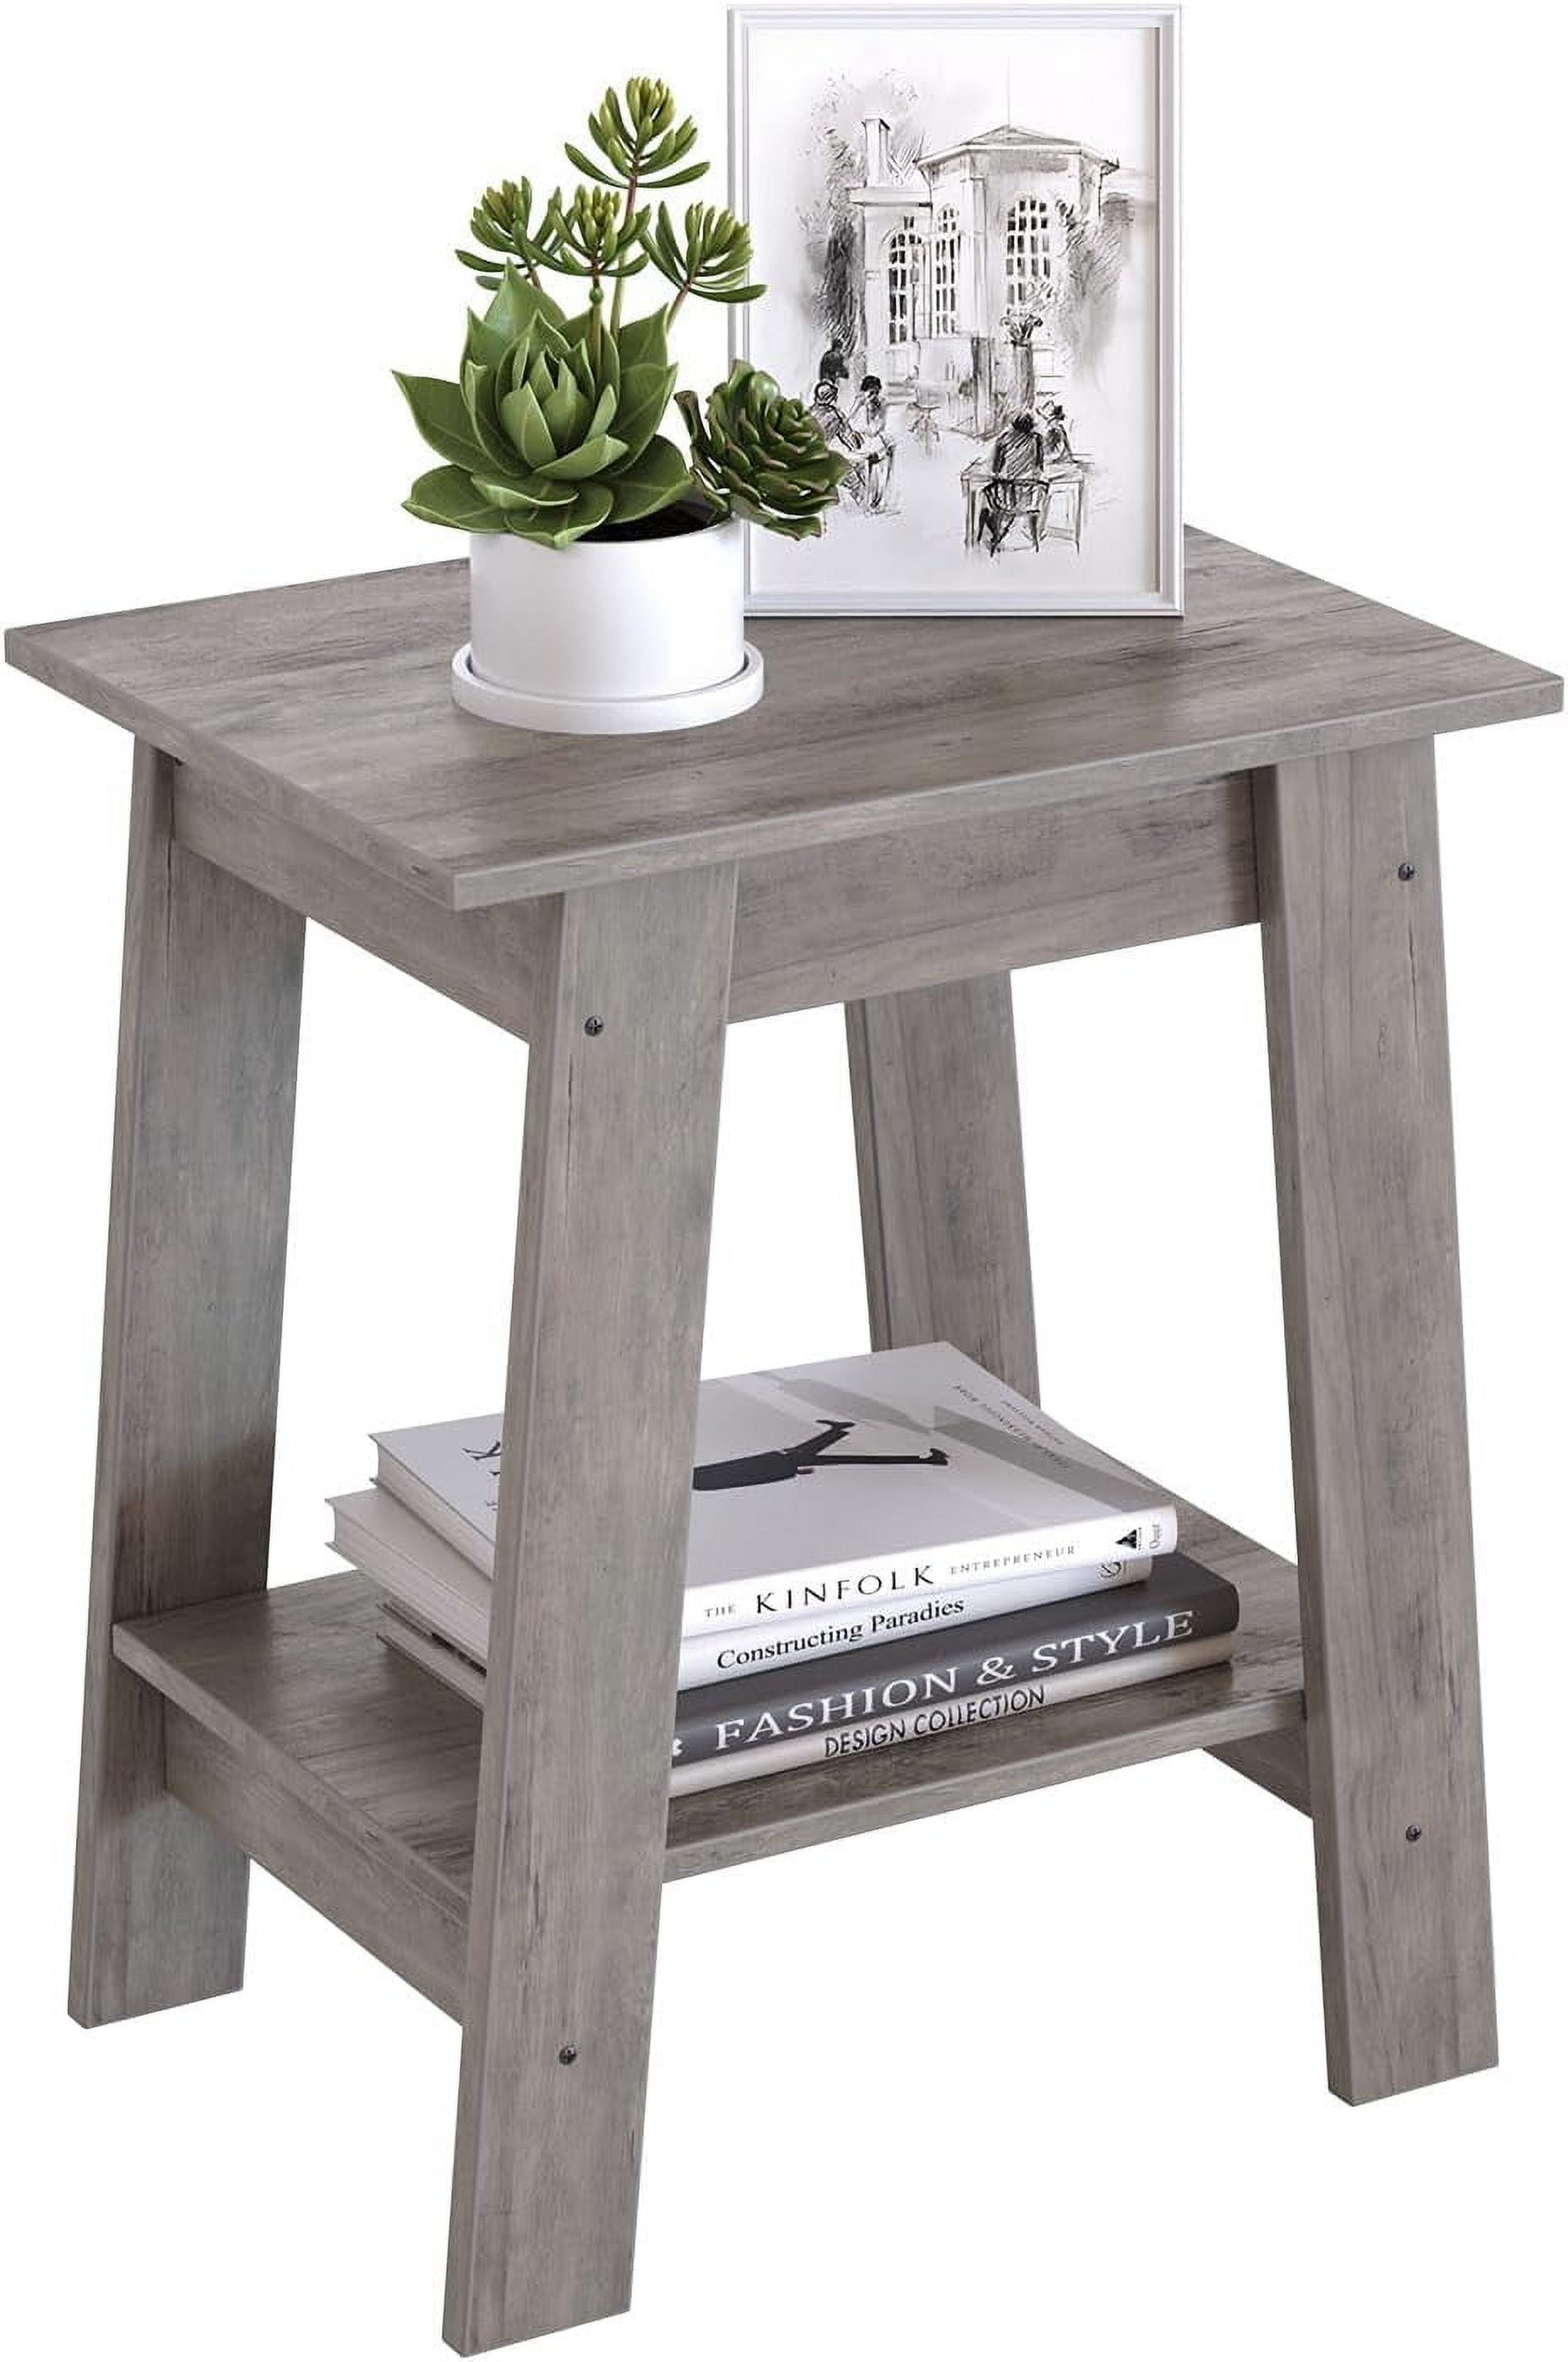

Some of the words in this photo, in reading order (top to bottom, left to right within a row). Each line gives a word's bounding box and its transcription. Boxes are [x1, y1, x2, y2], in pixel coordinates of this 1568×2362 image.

[705, 1603, 736, 1619] THE
[756, 1565, 934, 1614] KINFOLK
[950, 1545, 1076, 1576] ENTREPRENEUR
[716, 1624, 863, 1669] Constructing
[871, 1599, 964, 1634] Paradies
[715, 1666, 960, 1751] FASHION
[976, 1656, 1017, 1686] &
[1031, 1609, 1194, 1673] STYLE
[824, 1718, 906, 1759] DESIGN
[913, 1684, 1046, 1737] COLLECTION
